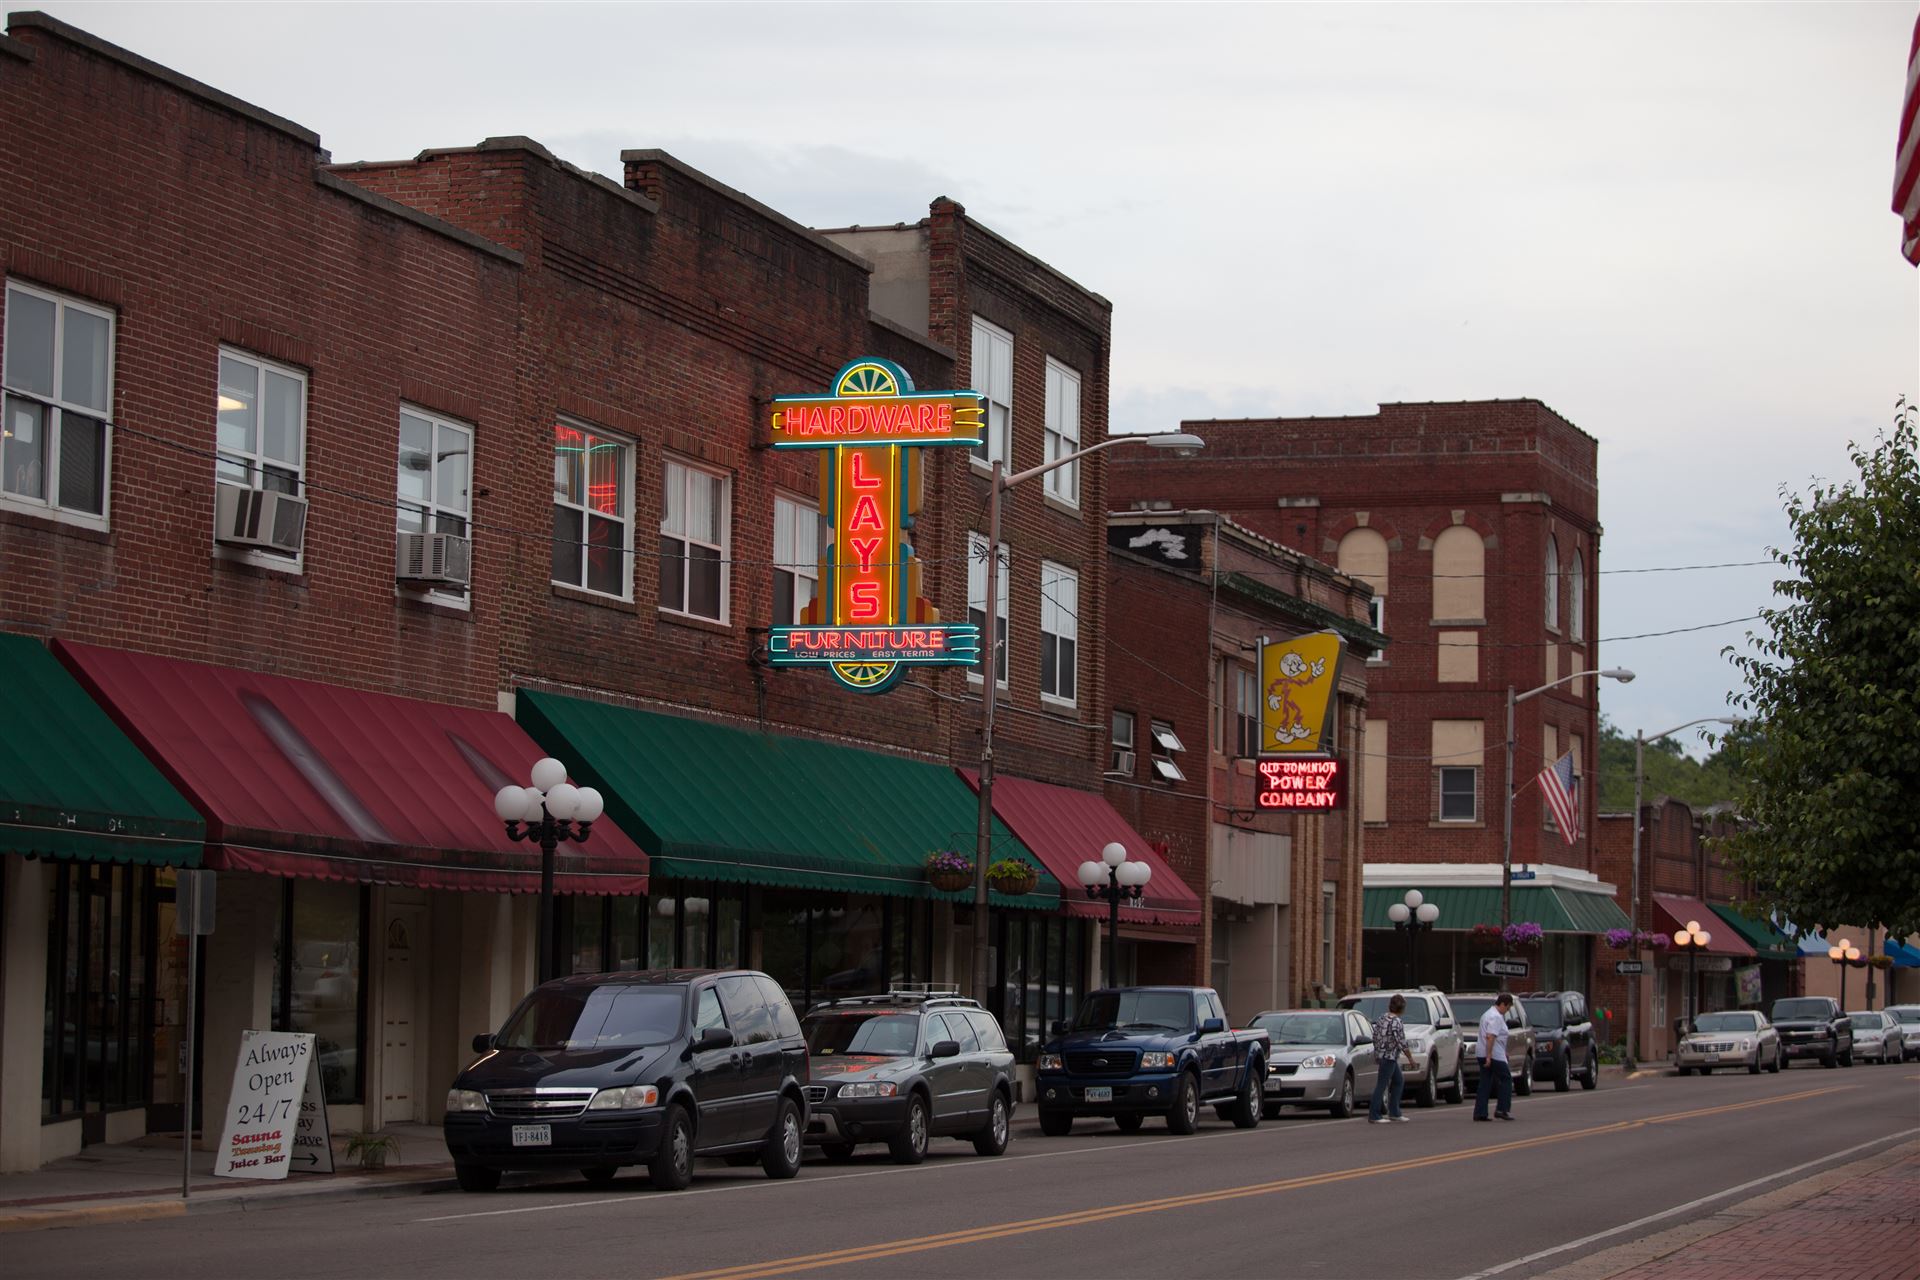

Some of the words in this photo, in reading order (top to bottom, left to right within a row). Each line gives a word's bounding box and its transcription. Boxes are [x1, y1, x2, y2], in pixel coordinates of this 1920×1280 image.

[785, 404, 952, 435] HARDWARE
[849, 452, 884, 619] LAYS
[789, 630, 944, 649] FURNITURE
[872, 650, 897, 658] EASY
[901, 649, 935, 657] TERMS
[1283, 761, 1337, 774] DOMINION
[1270, 776, 1326, 790] POWER
[1259, 791, 1337, 807] COMPANY
[245, 1042, 307, 1066] Always
[249, 1071, 295, 1095] Open
[237, 1099, 293, 1125] 24/7
[231, 1130, 283, 1146] Sauna
[231, 1143, 282, 1157] Tanning
[228, 1158, 260, 1172] Juice
[263, 1154, 286, 1165] Bar
